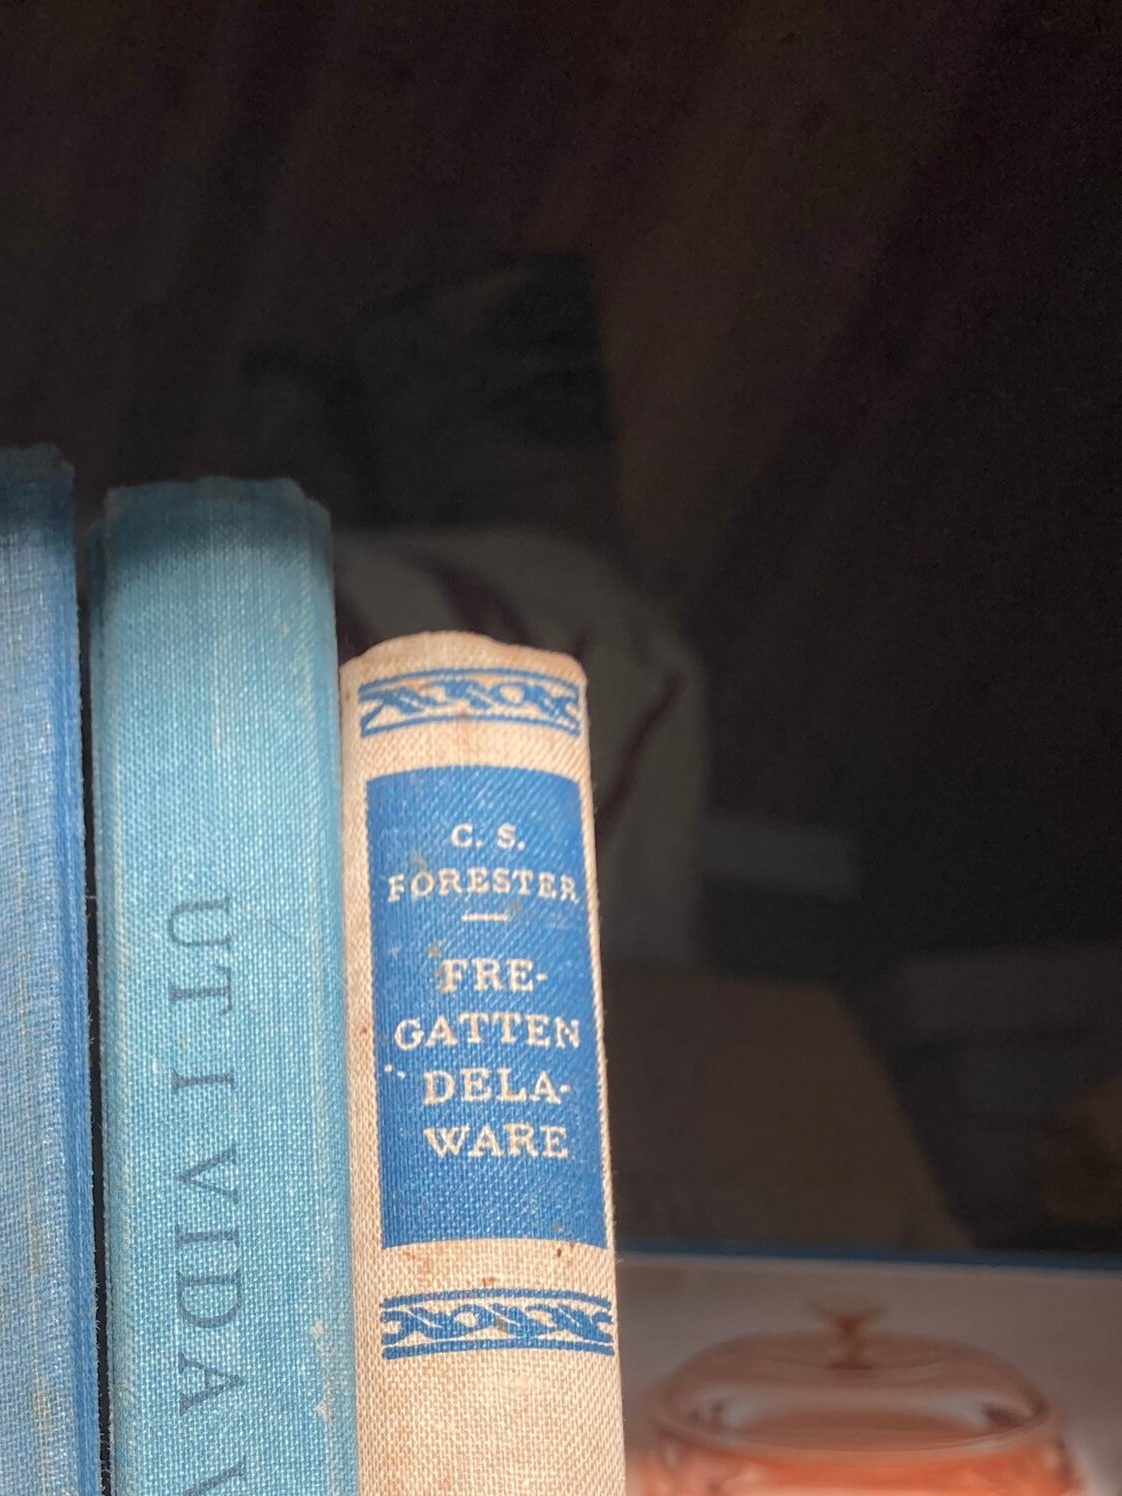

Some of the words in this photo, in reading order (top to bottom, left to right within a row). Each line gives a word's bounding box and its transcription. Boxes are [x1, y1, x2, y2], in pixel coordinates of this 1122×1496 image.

[449, 823, 484, 850] C.
[496, 823, 526, 851] S.
[387, 868, 578, 903] FORESTER
[166, 896, 234, 1016] UT
[438, 957, 549, 994] FRE-
[393, 1012, 581, 1051] GATTEN
[171, 1070, 236, 1095] I
[422, 1067, 572, 1105] DELA-
[422, 1122, 569, 1159] WARE
[176, 1147, 247, 1417] VIDA
